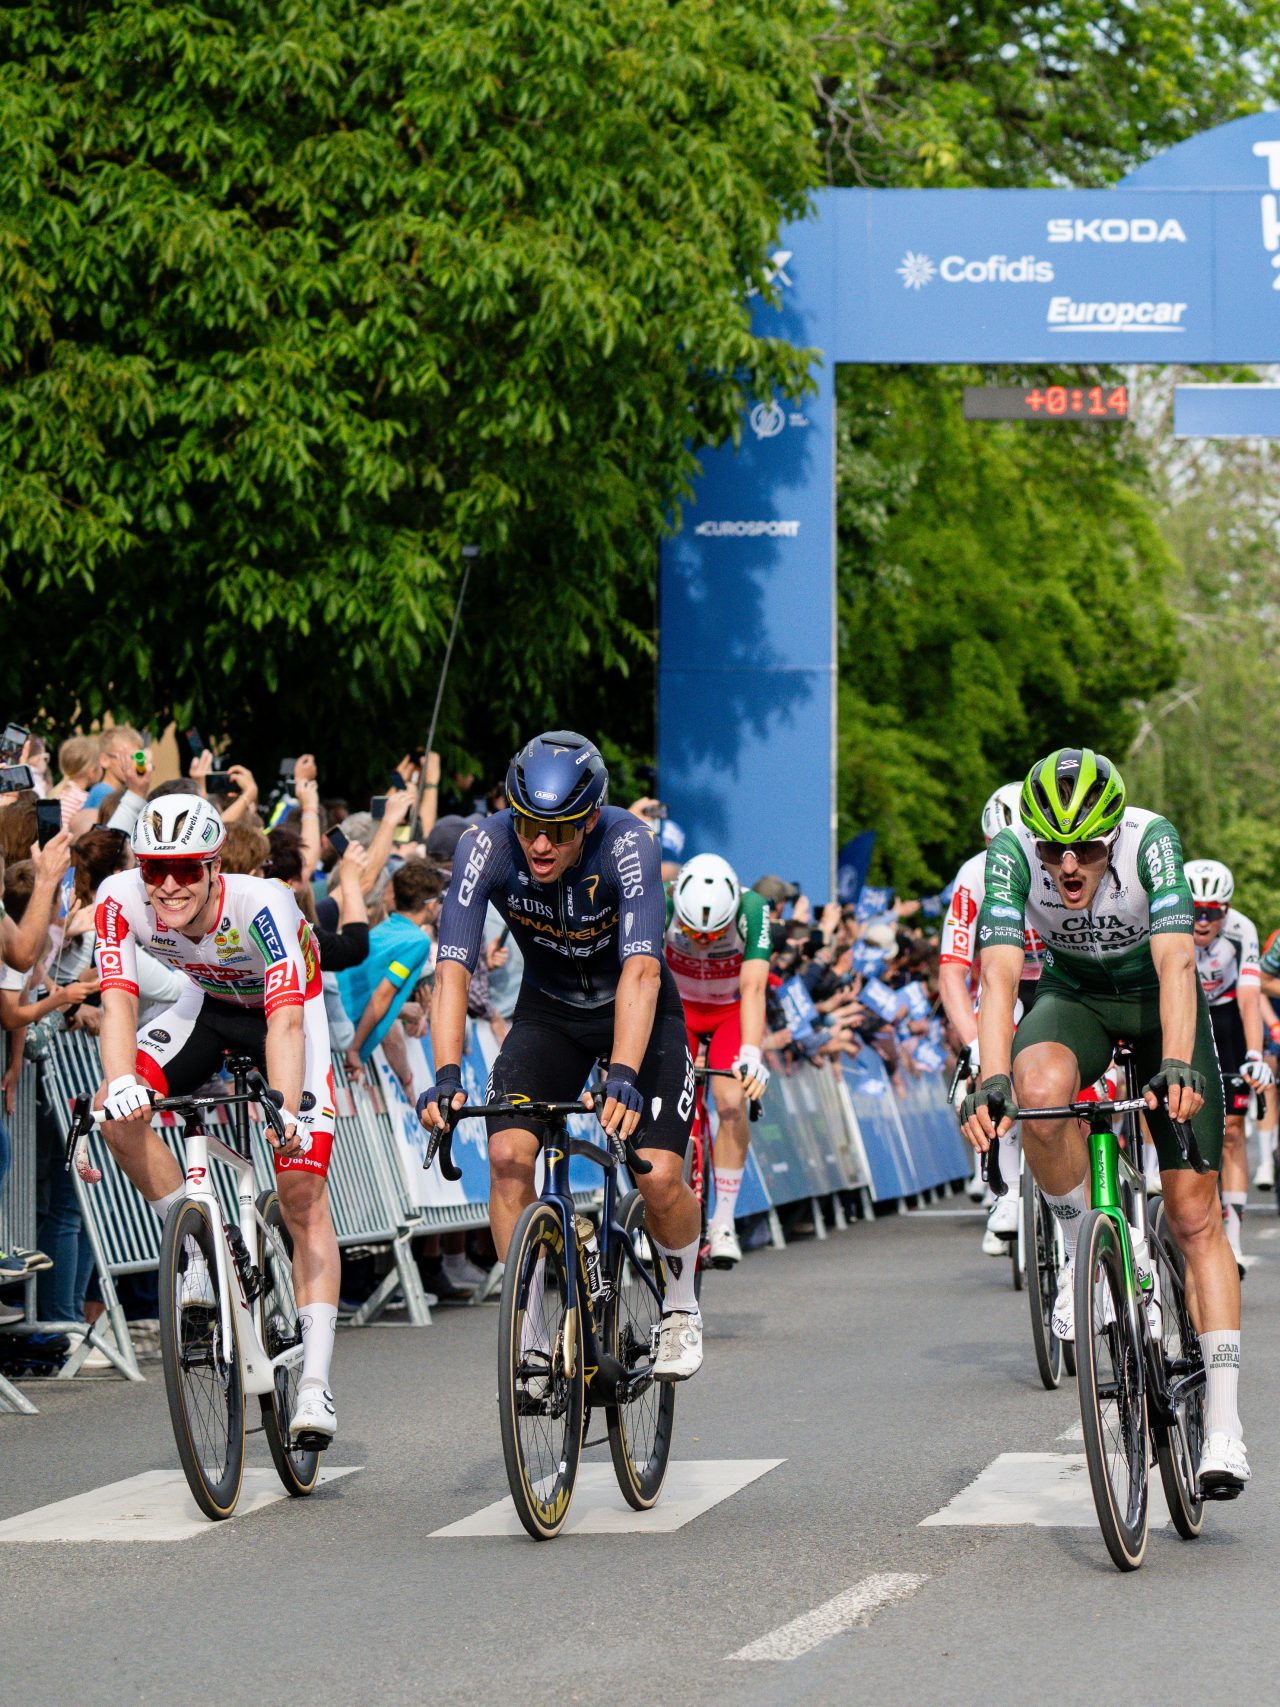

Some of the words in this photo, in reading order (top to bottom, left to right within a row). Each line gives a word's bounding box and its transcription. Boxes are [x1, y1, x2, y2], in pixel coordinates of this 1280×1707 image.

[1047, 219, 1187, 243] SKODA
[940, 255, 1055, 284] Cofidis
[1047, 297, 1187, 325] Europcar
[1025, 386, 1129, 416] +0:14
[458, 830, 493, 907] Q36.5
[617, 851, 643, 899] UBS
[1145, 842, 1164, 892] RGA
[1160, 836, 1176, 886] SEGUROS
[991, 853, 1015, 904] ALEA
[523, 898, 554, 919] UBS
[566, 886, 574, 917] Q36.5
[581, 906, 612, 922] SRAM
[105, 900, 119, 945] Pauwels
[255, 913, 284, 960] ALTEZ
[1049, 924, 1143, 945] RURAL
[1061, 914, 1126, 932] CAJA
[151, 934, 177, 947] Hertz
[440, 944, 468, 960] SGS
[623, 940, 652, 957] SGS
[266, 959, 296, 993] B!
[139, 1039, 165, 1053] Hertz
